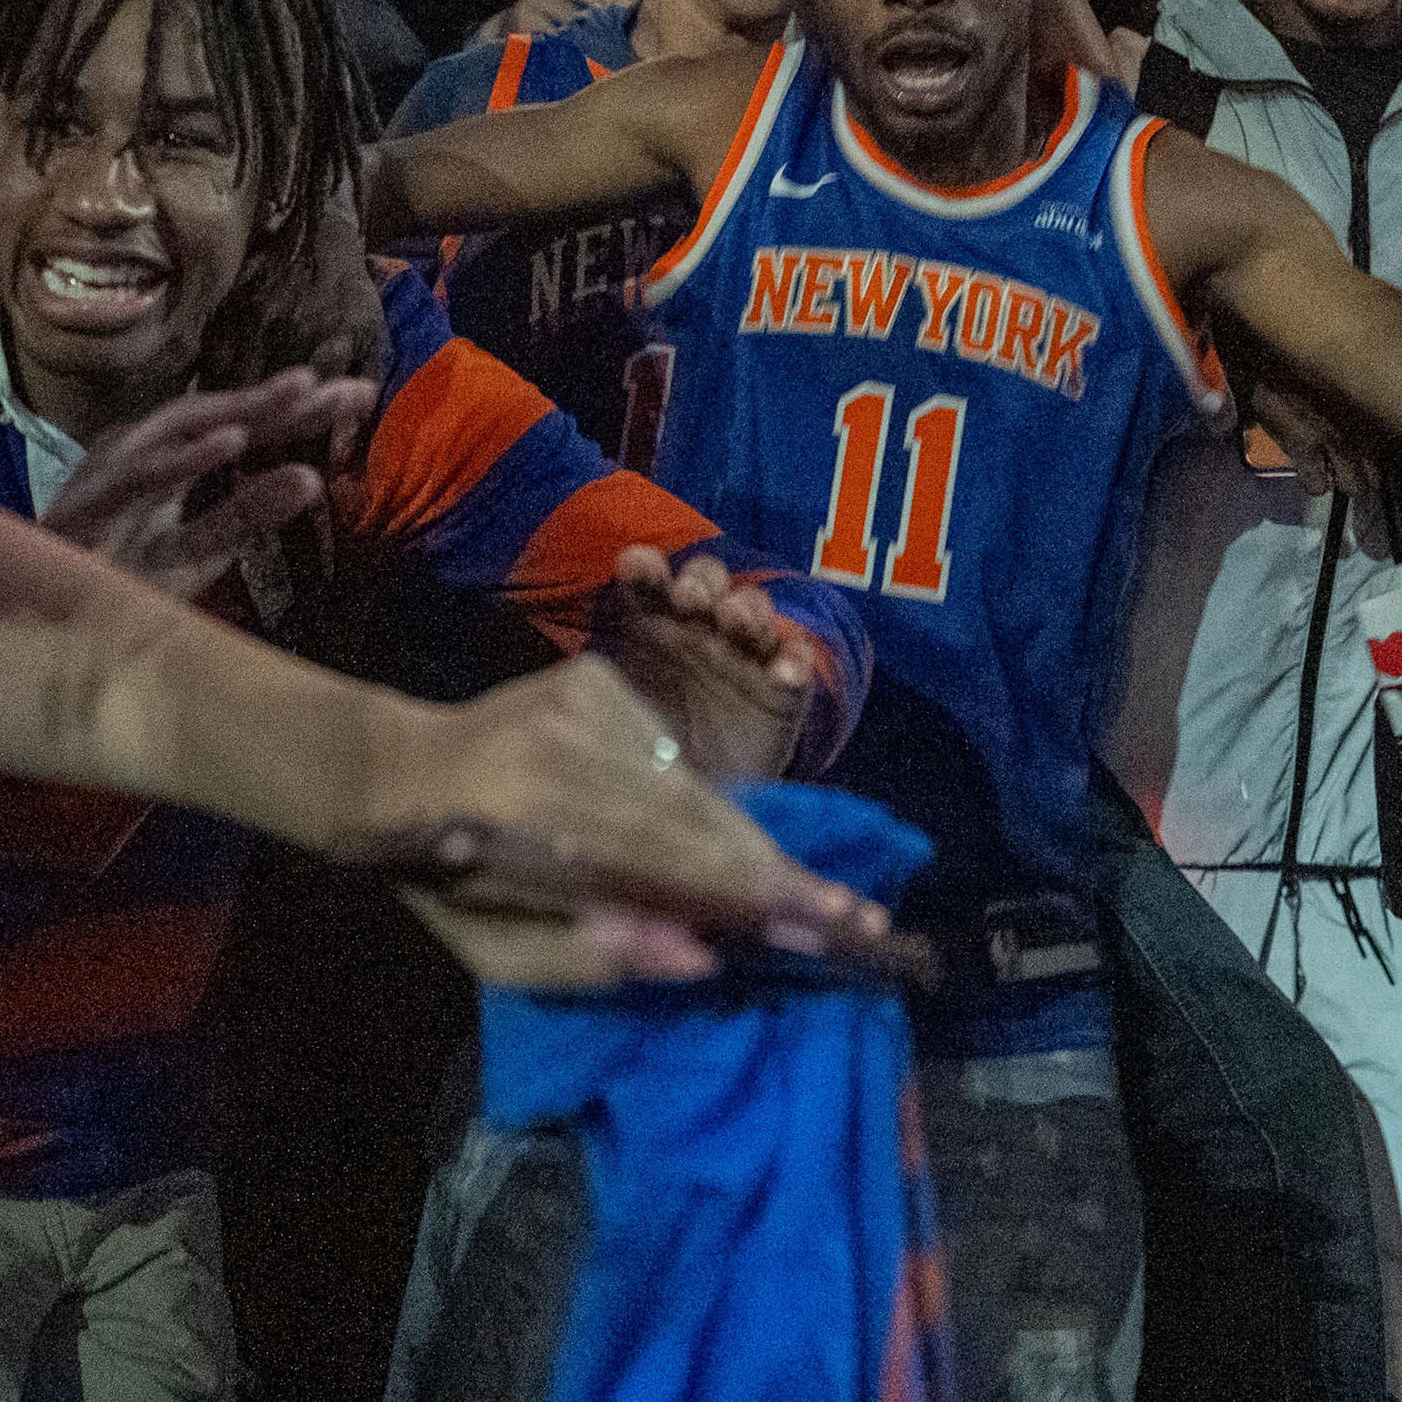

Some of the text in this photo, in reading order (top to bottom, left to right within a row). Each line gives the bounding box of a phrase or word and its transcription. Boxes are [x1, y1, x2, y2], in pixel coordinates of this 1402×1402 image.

[739, 245, 1101, 400] NEW YORK
[809, 380, 968, 603] 11
